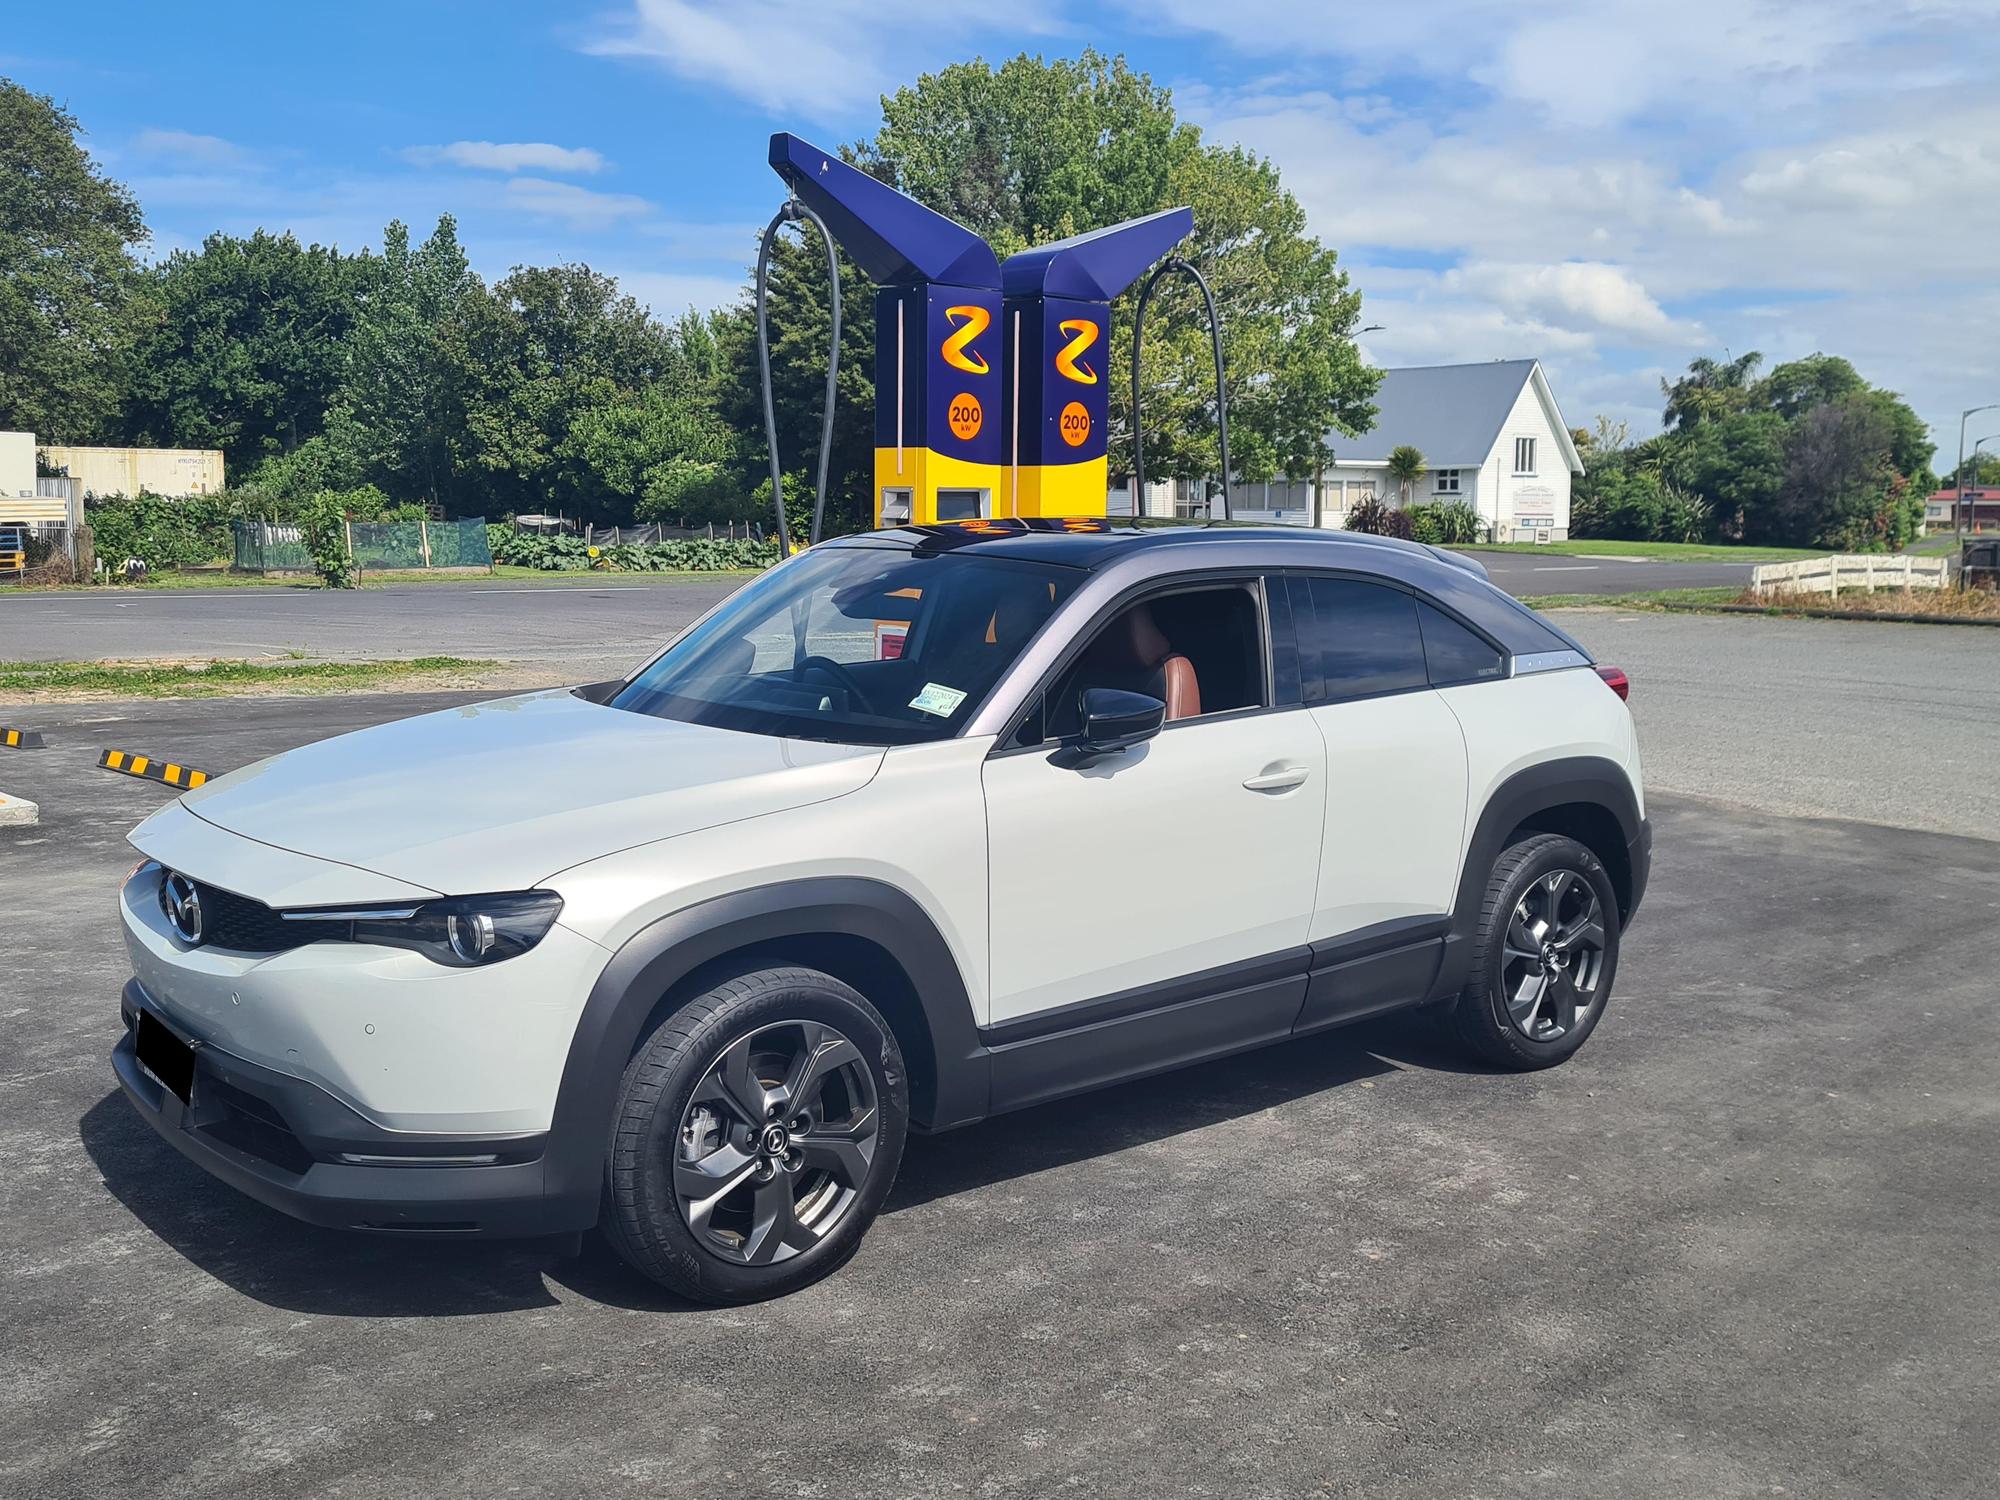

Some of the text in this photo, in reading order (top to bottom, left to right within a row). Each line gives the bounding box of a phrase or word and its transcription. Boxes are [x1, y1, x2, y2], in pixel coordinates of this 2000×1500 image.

[941, 305, 991, 375] Z
[1055, 319, 1099, 385] Z
[952, 406, 980, 423] 200
[1063, 414, 1088, 430] 200
